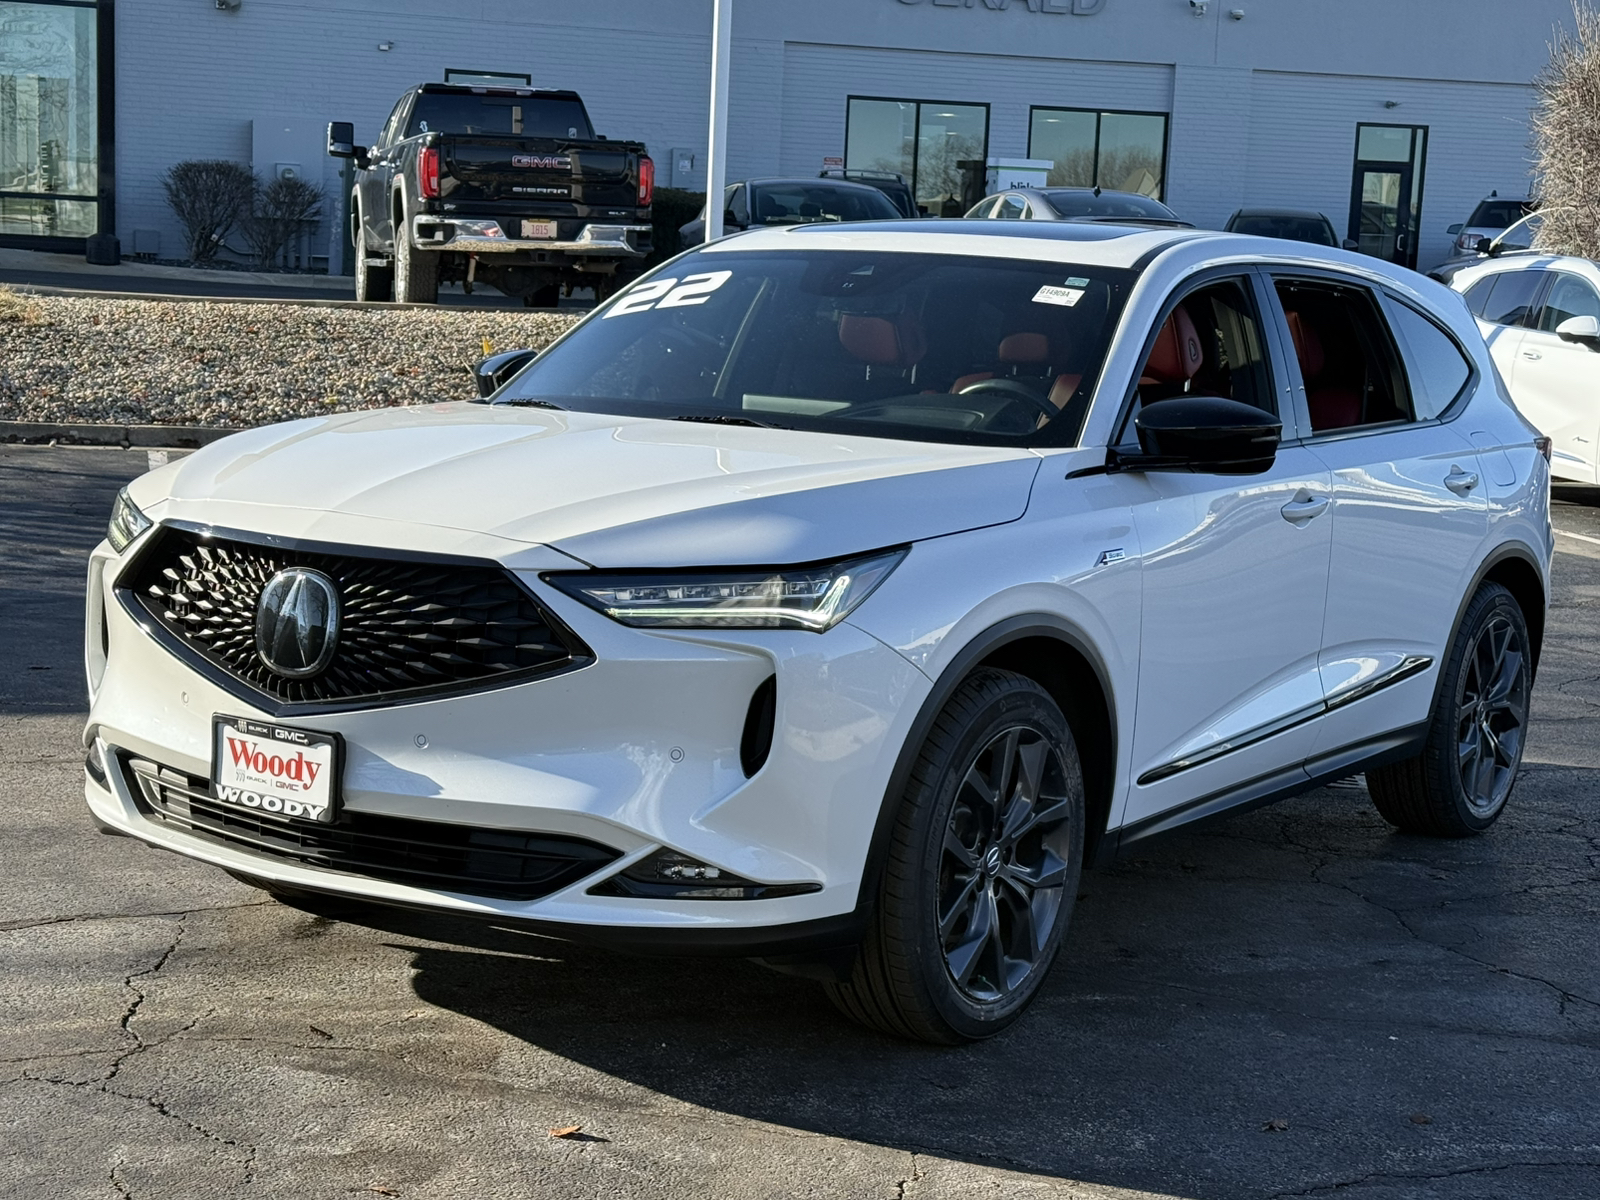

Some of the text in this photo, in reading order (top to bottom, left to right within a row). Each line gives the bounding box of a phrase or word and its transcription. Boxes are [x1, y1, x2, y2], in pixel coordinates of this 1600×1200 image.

[512, 155, 571, 169] GMC
[531, 224, 549, 235] 1815
[602, 270, 733, 319] 22
[248, 725, 305, 742] BUICK GMC
[226, 736, 322, 790] Woody
[246, 775, 299, 792] BUICK GMC
[215, 783, 326, 821] WOODY
